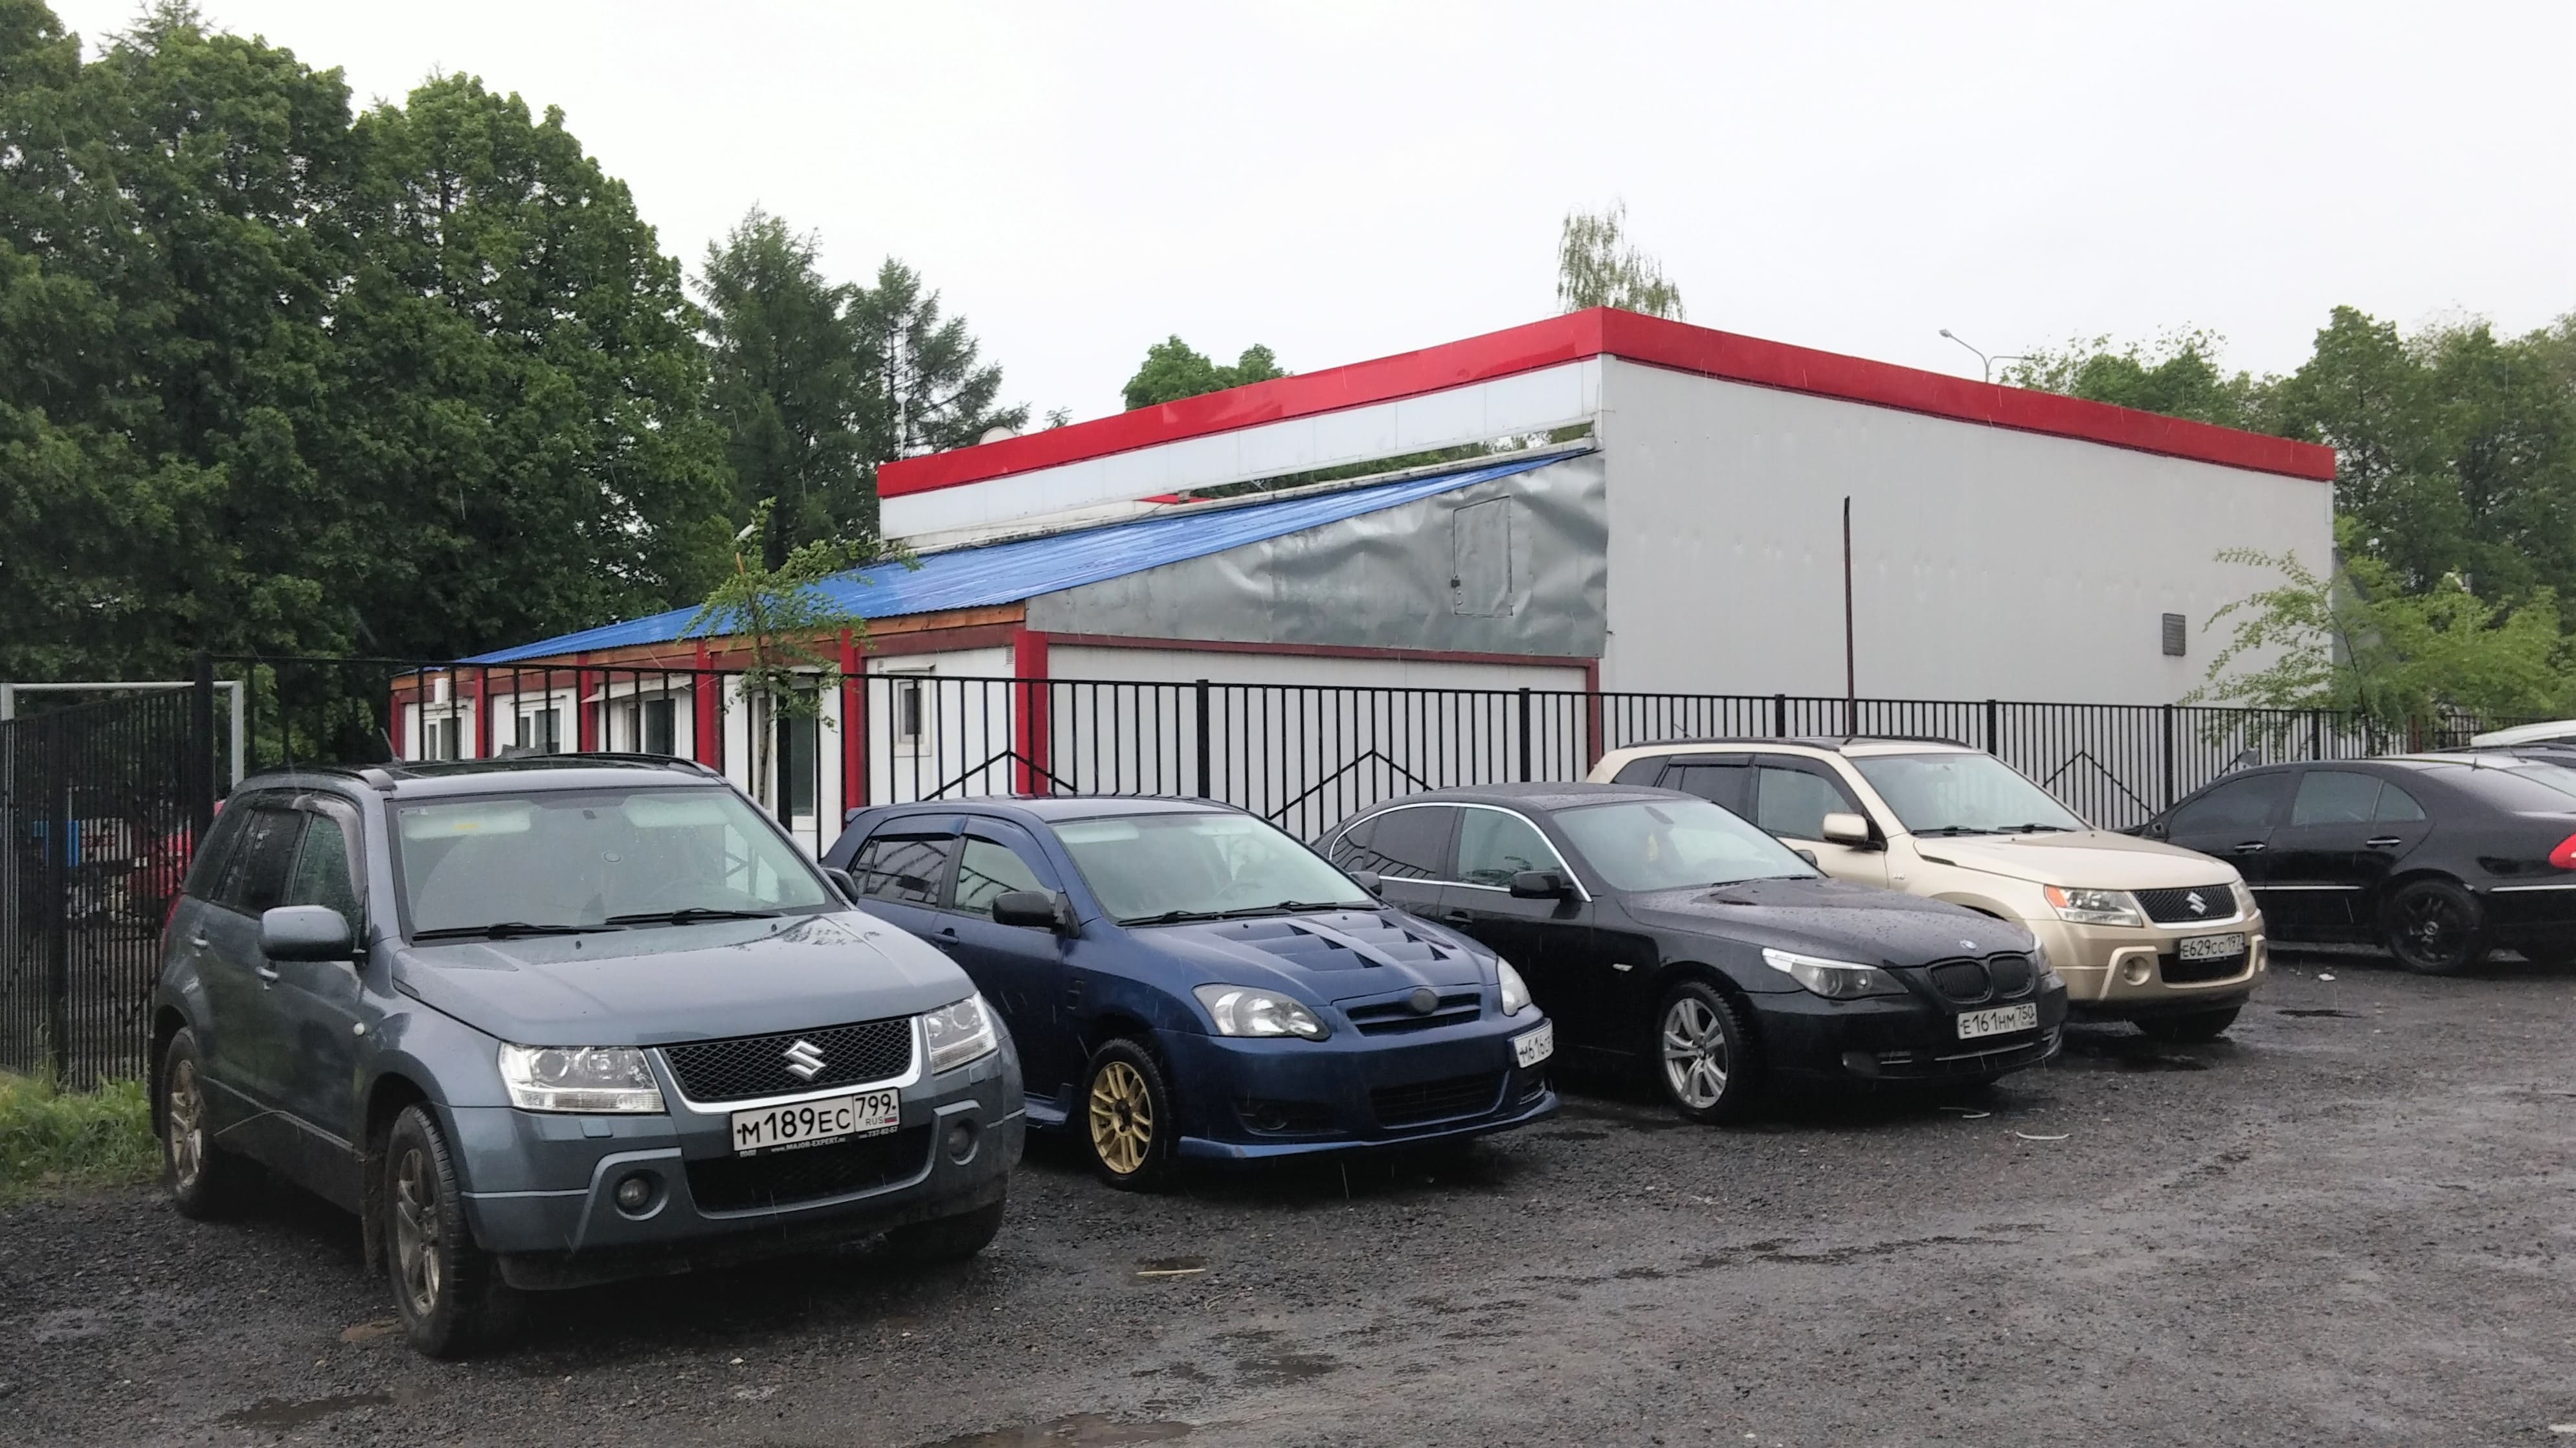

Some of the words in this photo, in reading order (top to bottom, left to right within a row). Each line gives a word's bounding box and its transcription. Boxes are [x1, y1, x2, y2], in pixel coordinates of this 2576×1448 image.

[1963, 1012, 2015, 1034] Е161НМ
[741, 1107, 851, 1145] М189ЕС
[855, 1093, 891, 1119] 799
[866, 1116, 884, 1126] RUS
